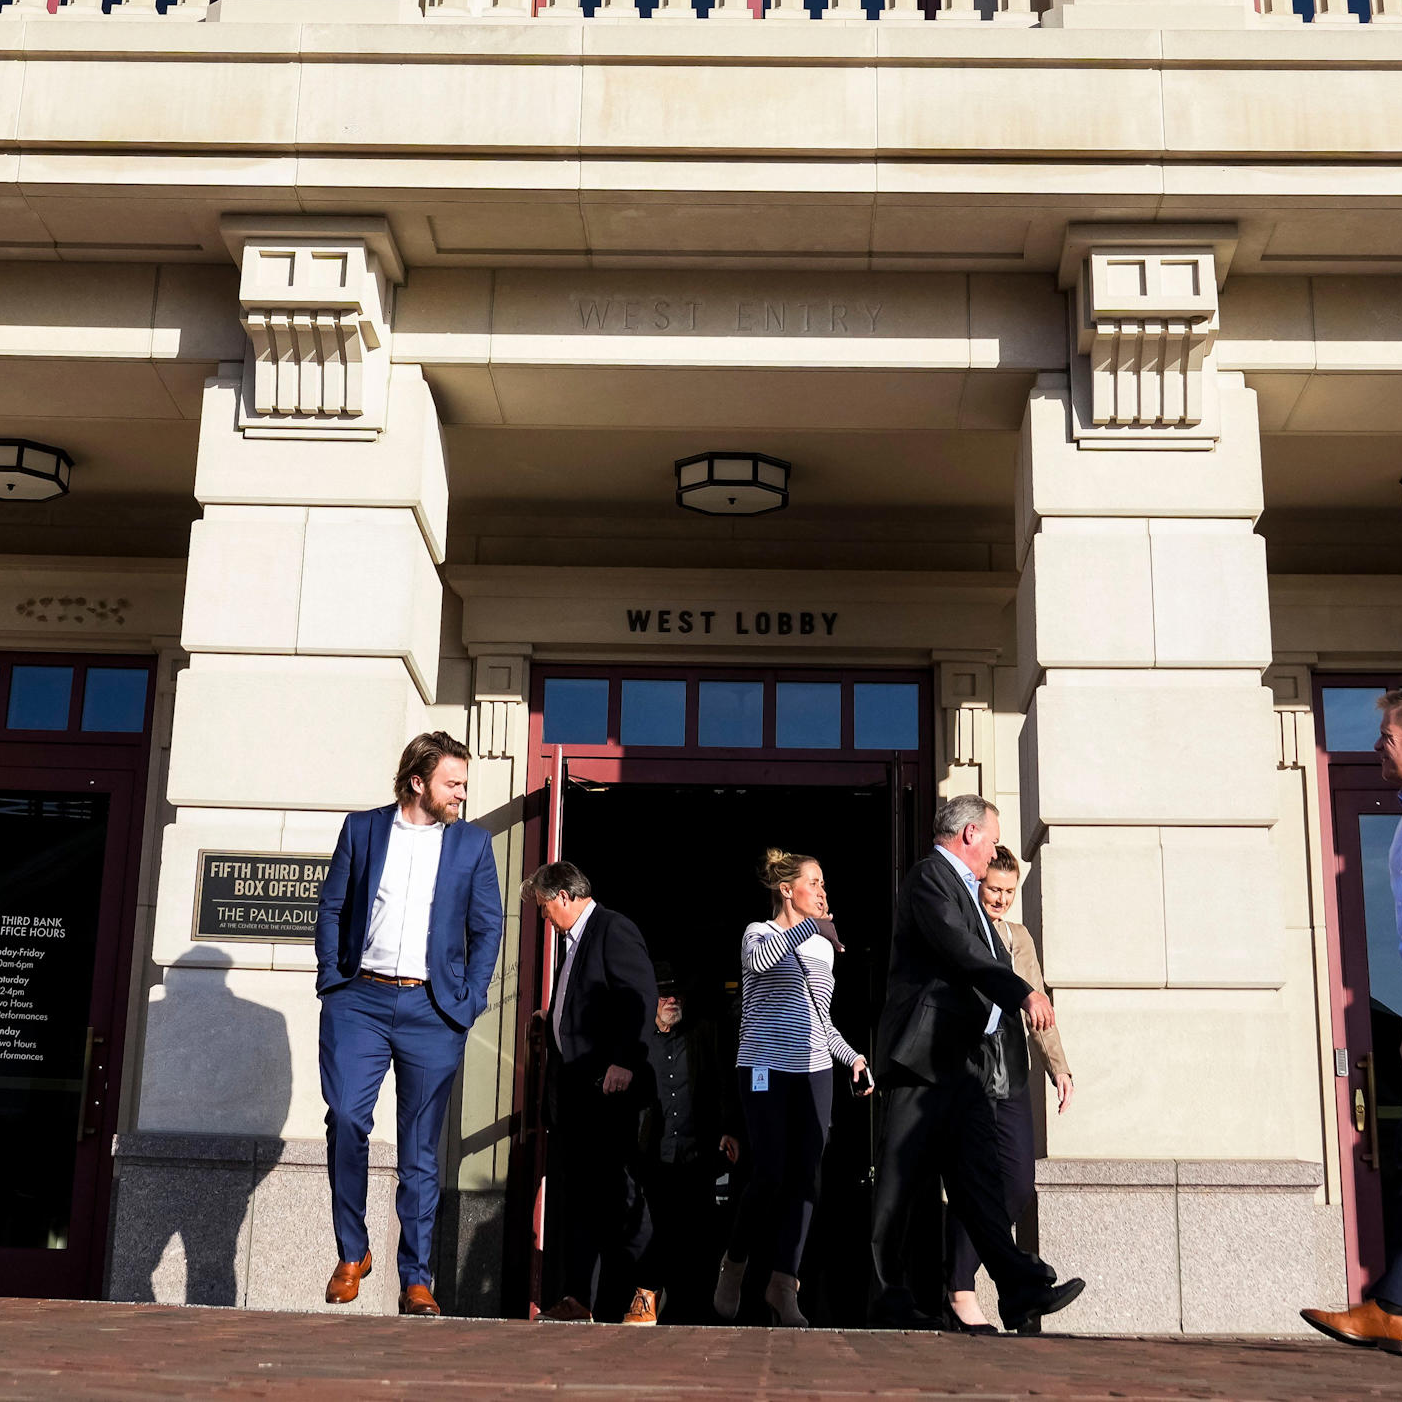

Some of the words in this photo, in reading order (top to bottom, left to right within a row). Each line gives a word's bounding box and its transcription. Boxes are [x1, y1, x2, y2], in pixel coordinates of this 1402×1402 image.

[573, 298, 703, 331] WEST
[734, 301, 885, 334] ENTRY
[626, 609, 716, 634] WEST
[736, 611, 839, 636] LOBBY
[210, 861, 252, 879] FIFTH
[256, 863, 300, 881] THIRD
[303, 864, 329, 881] BA
[234, 879, 265, 896] BOX
[268, 881, 319, 898] OFFICE
[2, 916, 30, 925] THIRD
[33, 917, 62, 927] BANK
[217, 907, 245, 922] THE
[249, 908, 319, 924] PALLADIU
[30, 928, 65, 938] HOURS
[10, 999, 33, 1008] Hours
[14, 1039, 36, 1048] Hours
